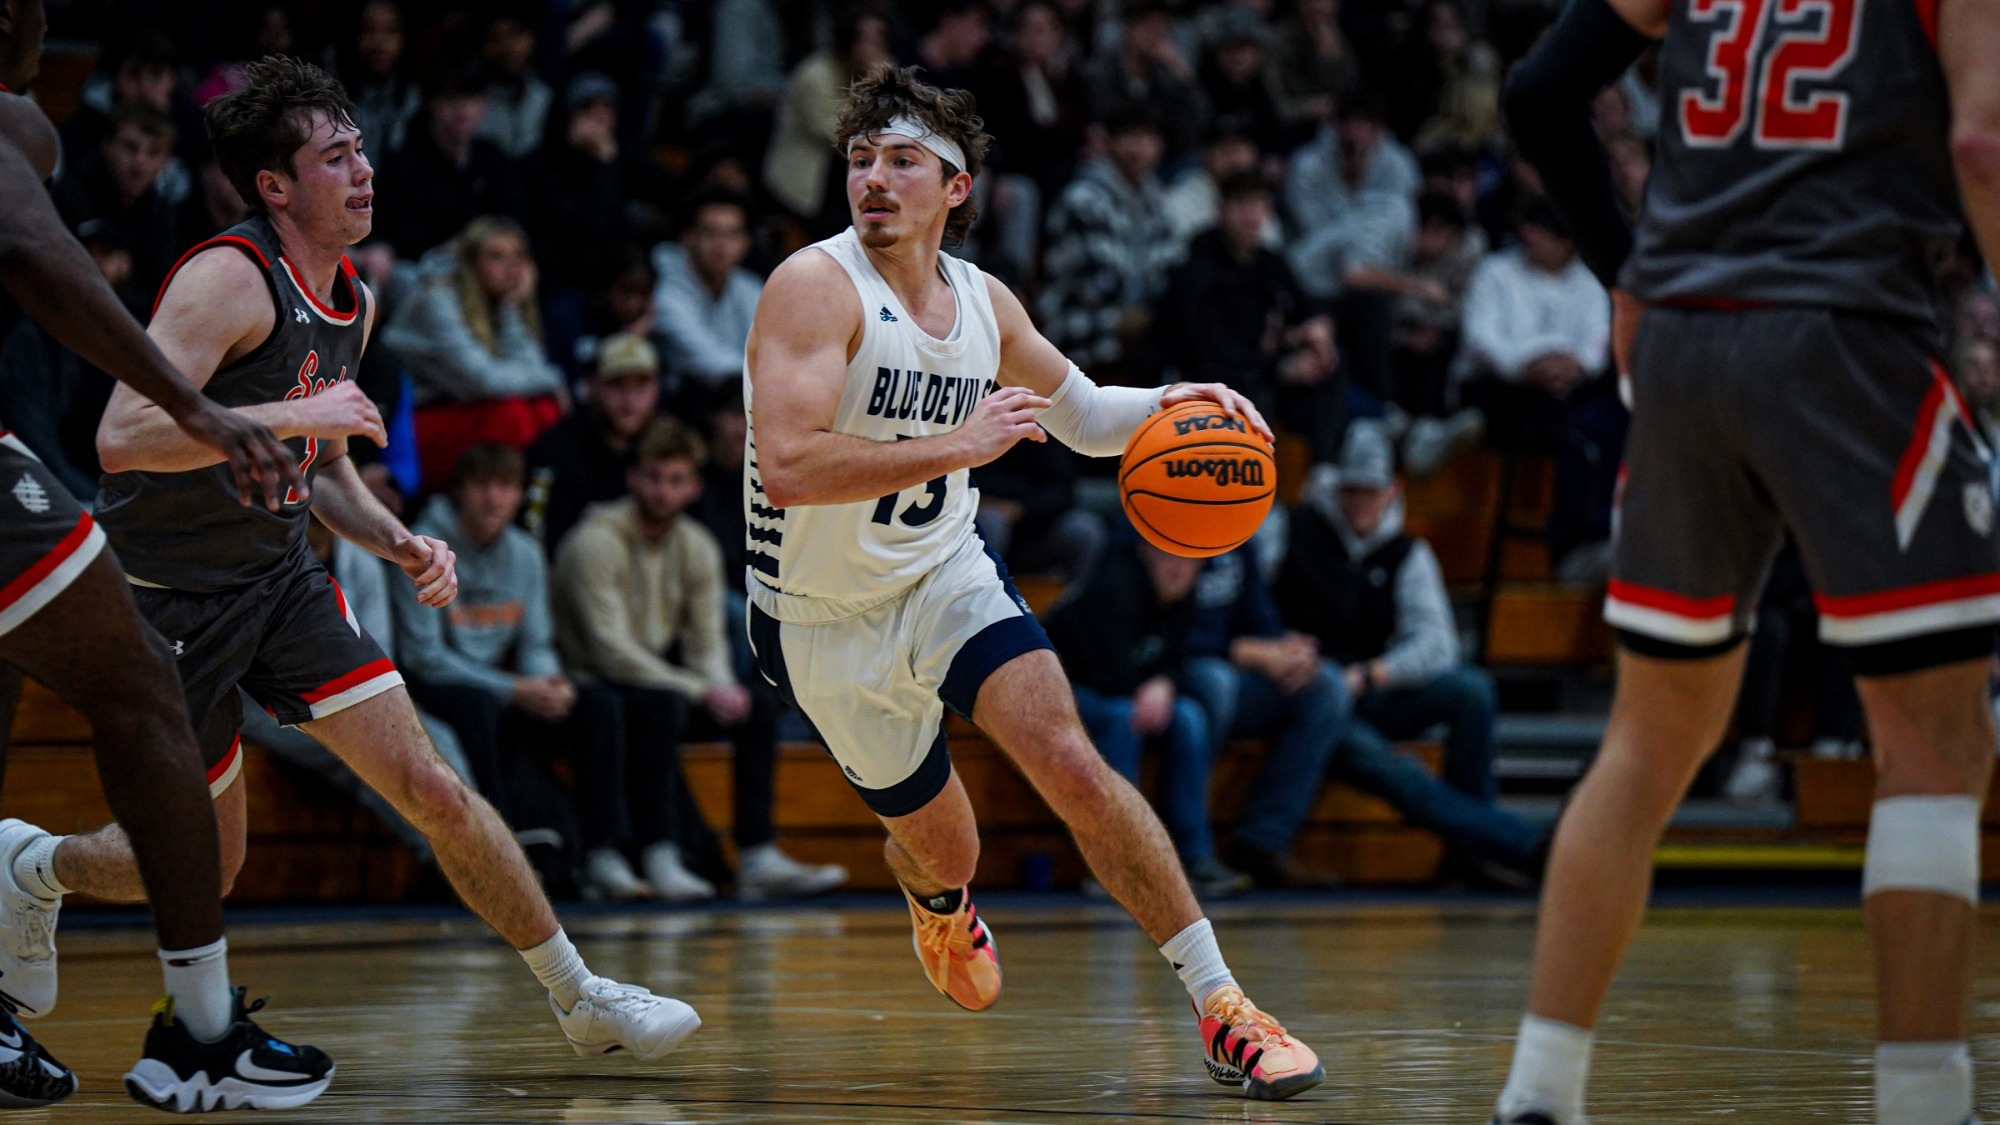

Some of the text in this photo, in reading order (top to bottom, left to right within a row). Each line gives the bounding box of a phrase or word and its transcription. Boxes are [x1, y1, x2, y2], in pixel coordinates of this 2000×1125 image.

[1679, 0, 1864, 148] 32
[867, 367, 923, 421] BLUE
[1174, 414, 1246, 436] NCAA
[1162, 458, 1265, 487] Wilson
